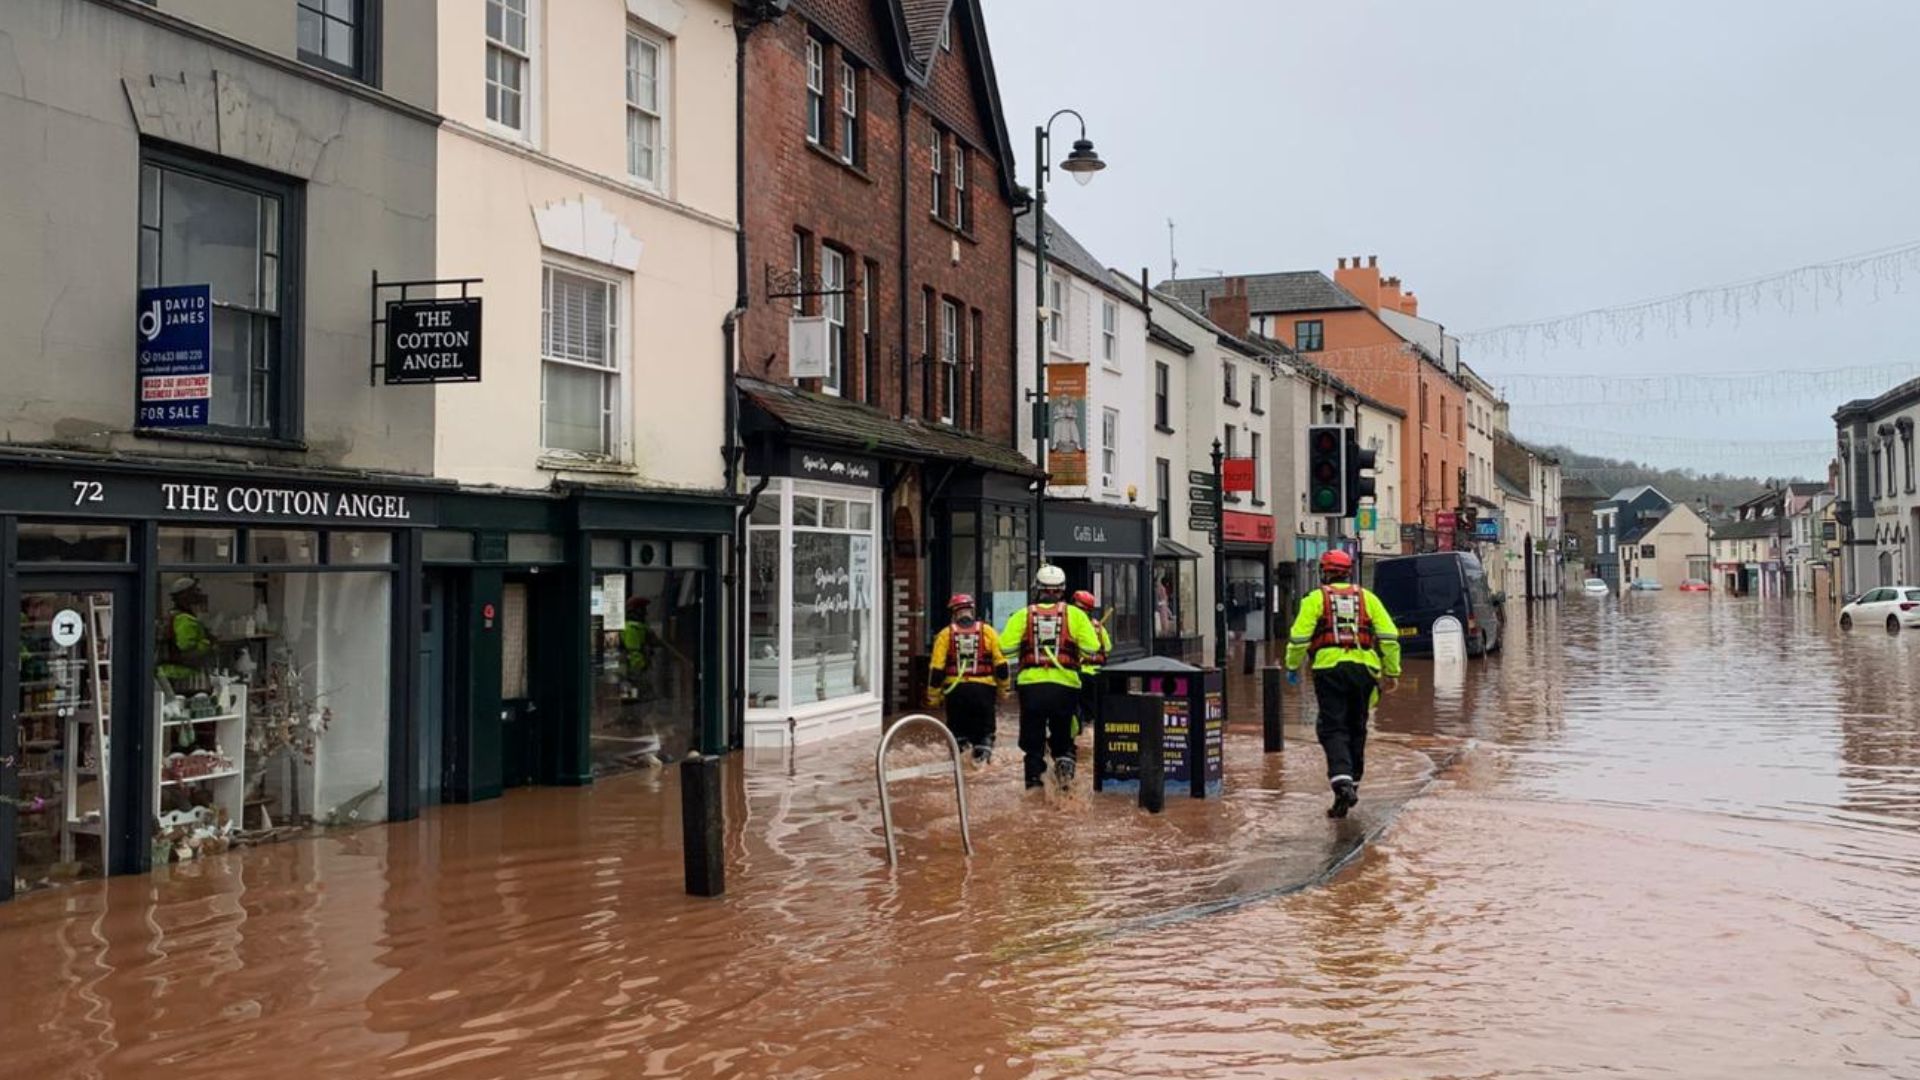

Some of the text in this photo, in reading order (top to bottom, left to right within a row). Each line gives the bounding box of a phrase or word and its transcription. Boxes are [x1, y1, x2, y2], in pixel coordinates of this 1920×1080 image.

[165, 297, 205, 311] DAVID
[166, 311, 205, 325] JAMES
[414, 310, 452, 327] THE
[397, 330, 469, 349] COTTON
[403, 352, 464, 370] ANGEL
[140, 405, 200, 420] FOR SALE
[73, 481, 104, 505] 72
[162, 484, 410, 519] THE COTTON ANGEL
[1108, 741, 1138, 752] LITTER
